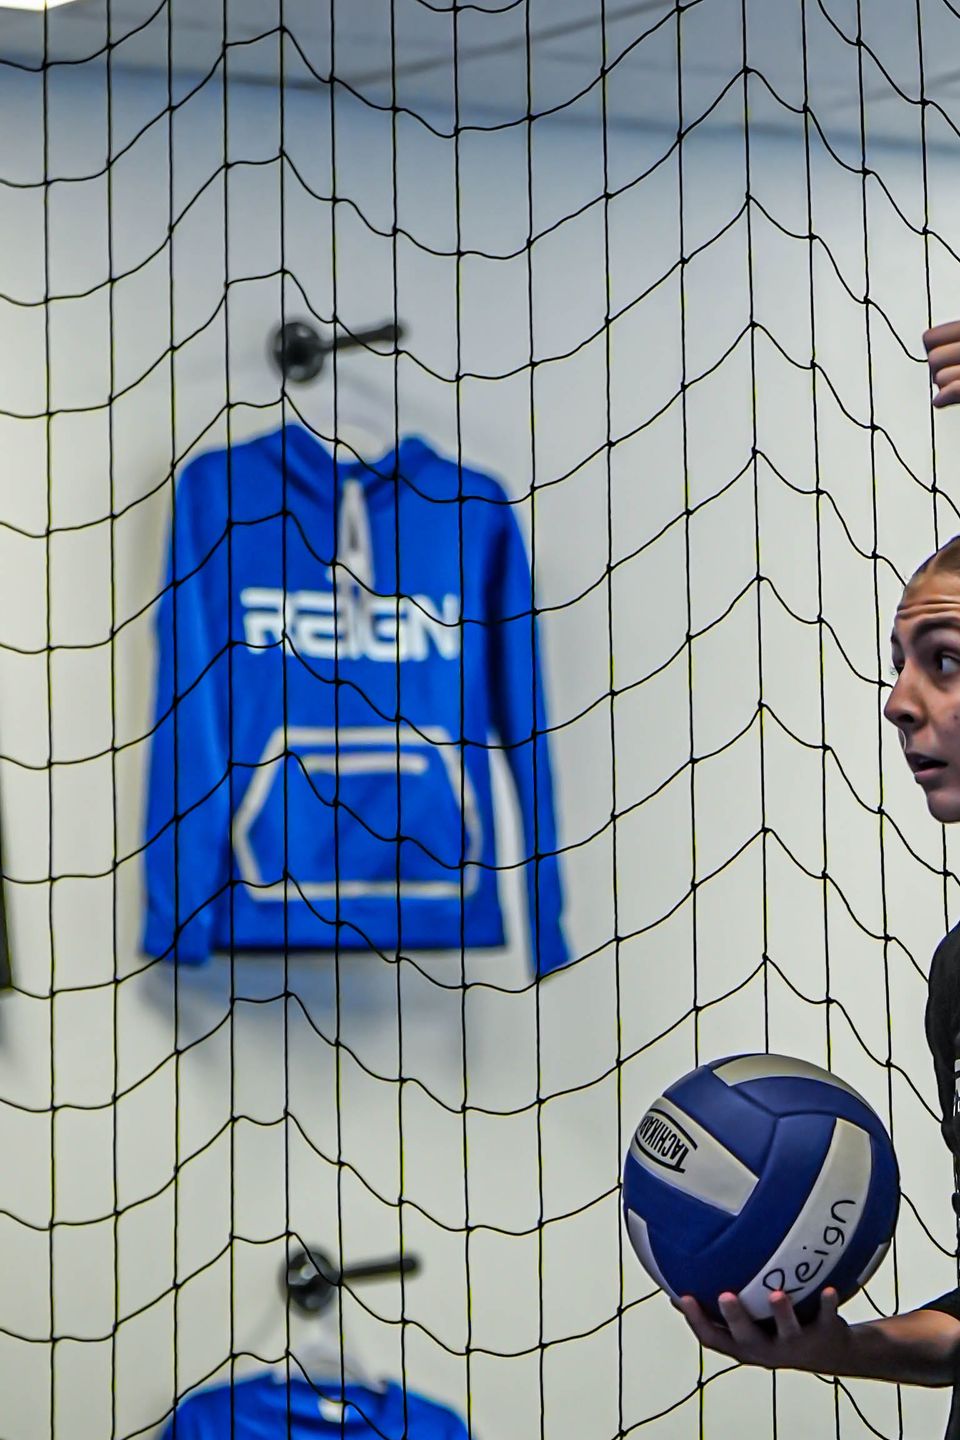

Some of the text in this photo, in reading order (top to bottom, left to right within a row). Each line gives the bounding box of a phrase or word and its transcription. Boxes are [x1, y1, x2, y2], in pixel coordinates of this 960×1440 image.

[240, 587, 461, 662] REIGN
[635, 1115, 689, 1174] TACHIKAR
[762, 1199, 856, 1293] Reign
